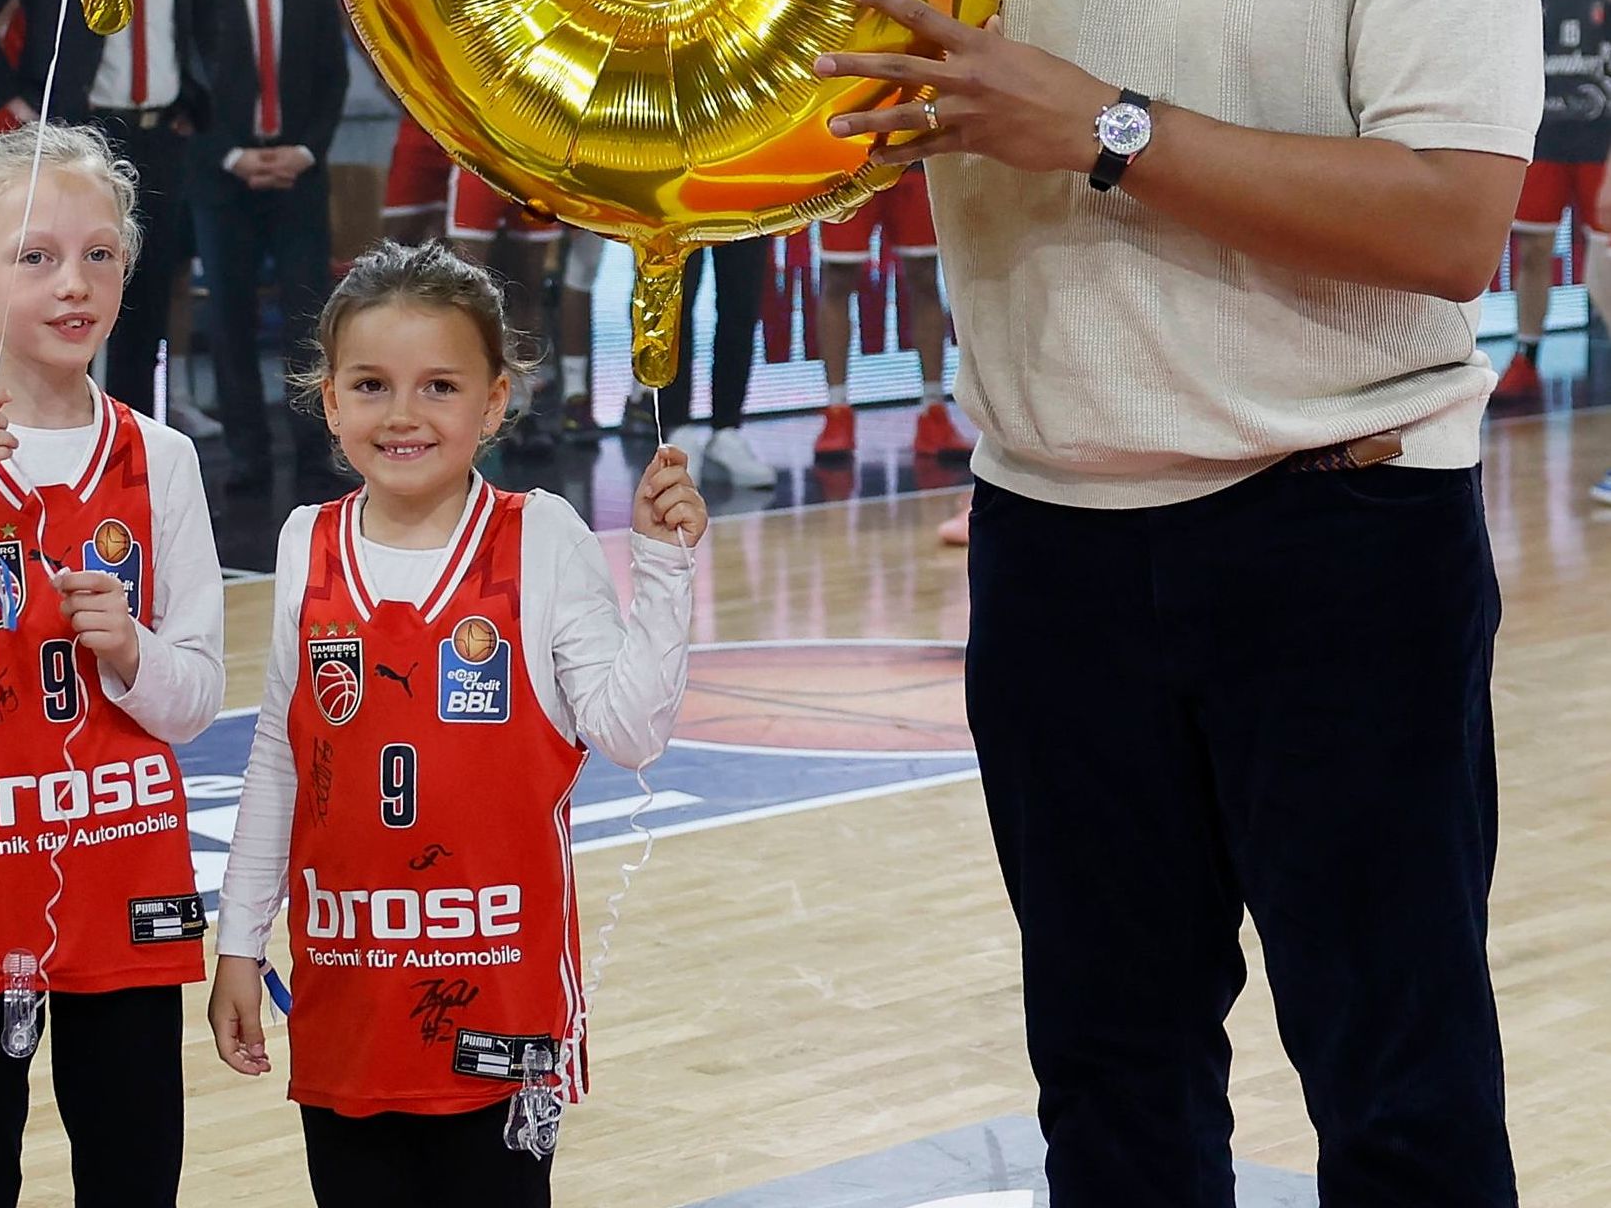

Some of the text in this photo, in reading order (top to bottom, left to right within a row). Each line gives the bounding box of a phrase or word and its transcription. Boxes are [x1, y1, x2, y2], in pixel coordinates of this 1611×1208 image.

[312, 643, 357, 653] BAMBERG
[40, 638, 79, 723] 9
[463, 679, 501, 691] Credit
[446, 691, 500, 713] BBL
[379, 743, 419, 829] 9
[35, 830, 68, 852] für
[72, 811, 180, 848] Automobile
[134, 901, 198, 919] PUMA S
[302, 867, 522, 941] brose
[306, 944, 522, 969] Techni für Automobile
[461, 1033, 493, 1048] PUMA
